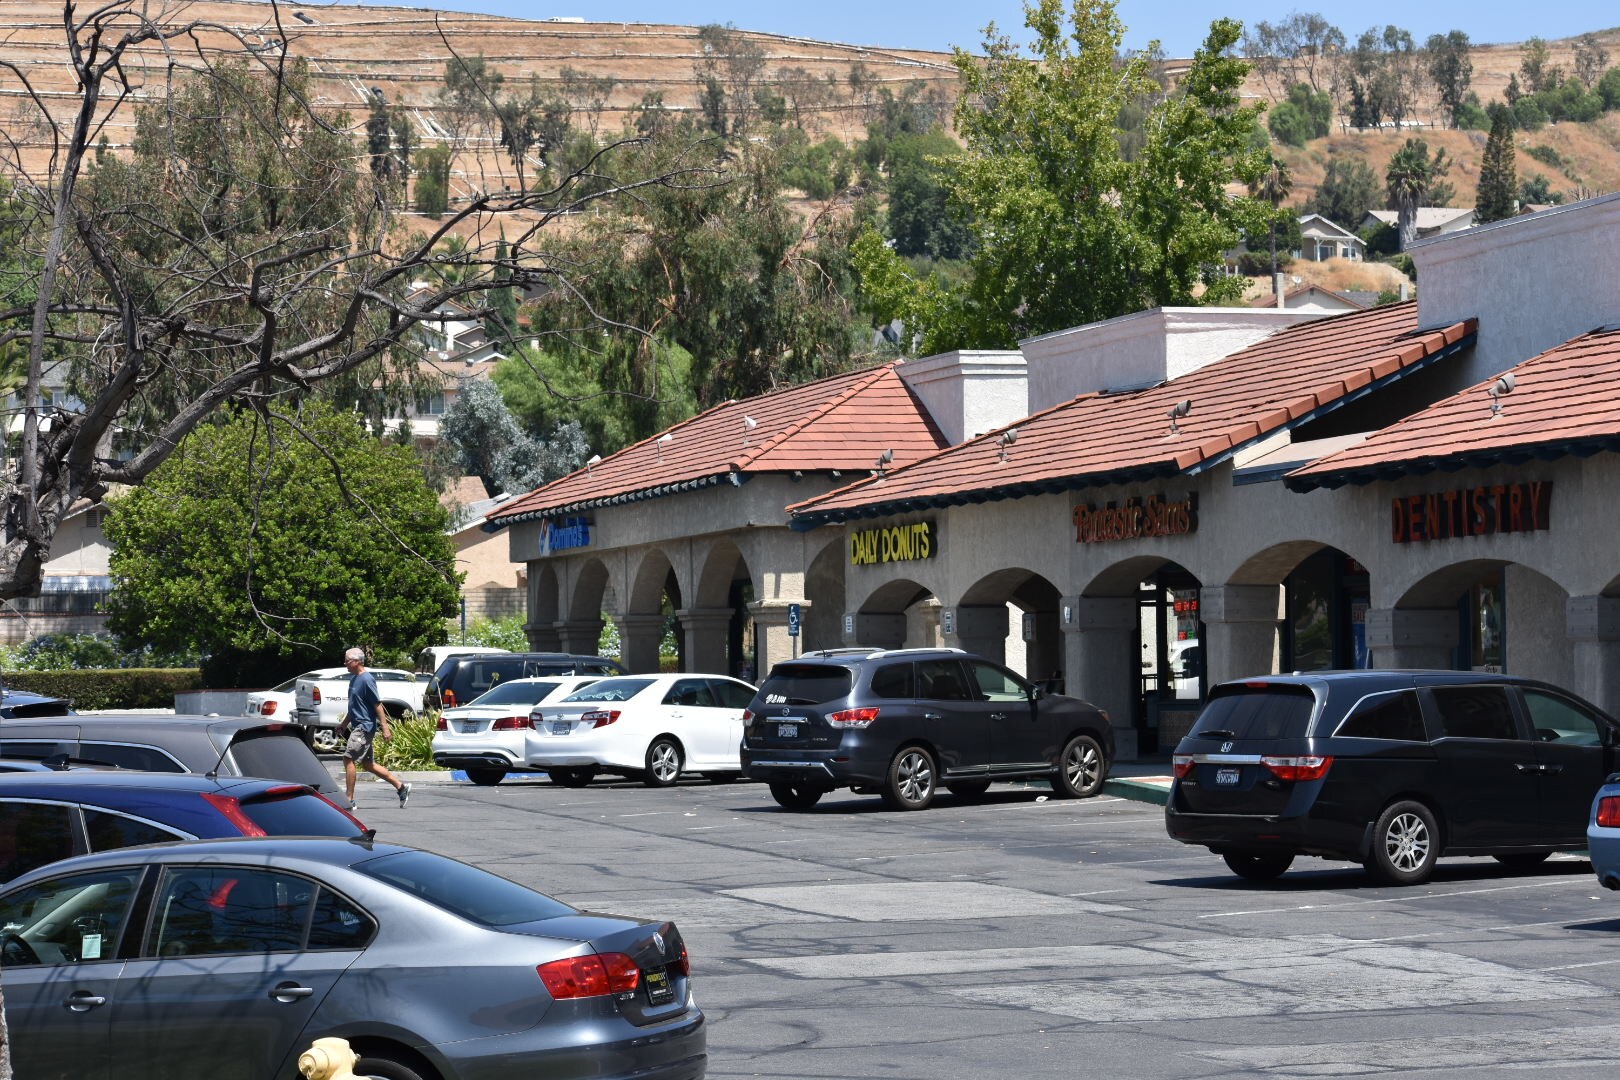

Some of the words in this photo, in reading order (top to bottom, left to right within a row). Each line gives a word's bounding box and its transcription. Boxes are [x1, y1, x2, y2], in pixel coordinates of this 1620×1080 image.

[1392, 481, 1543, 543] DENTISTRY
[851, 529, 879, 565] DAILY
[882, 521, 929, 563] DONUTS
